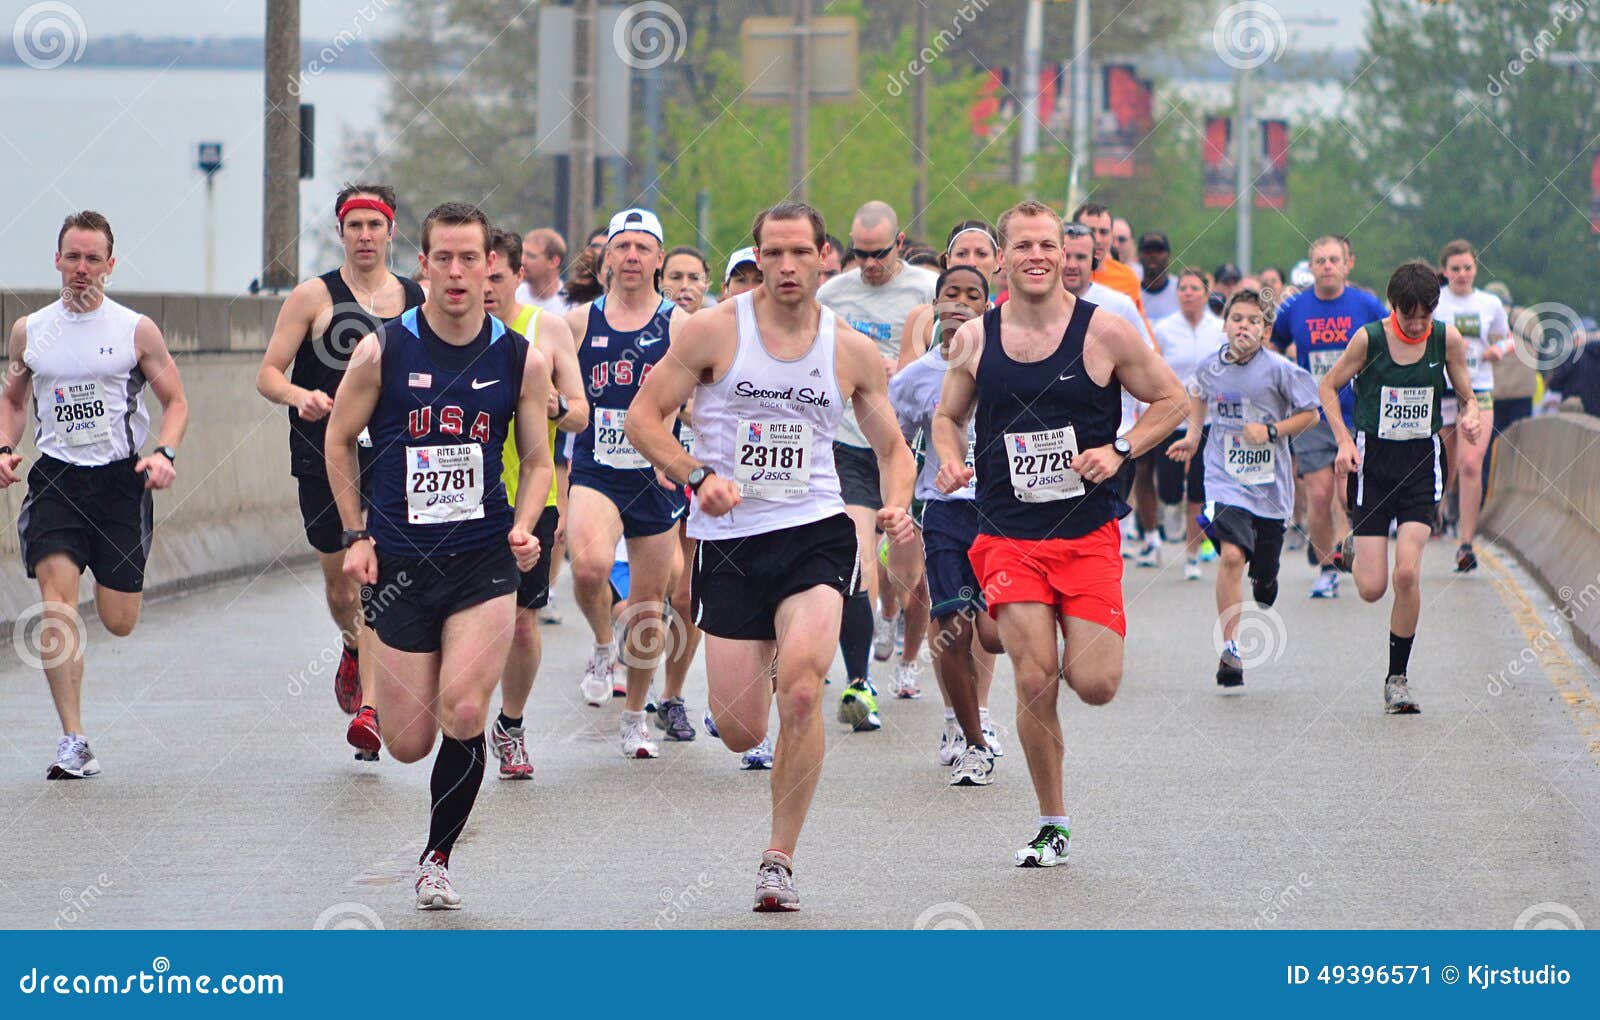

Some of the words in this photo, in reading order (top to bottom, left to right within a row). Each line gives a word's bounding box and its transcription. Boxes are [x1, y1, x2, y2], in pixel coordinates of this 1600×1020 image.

[1305, 316, 1351, 331] TEAM
[1311, 329, 1348, 345] FOX
[735, 381, 793, 400] Second
[796, 388, 830, 408] Sole
[55, 400, 104, 422] 23658
[1218, 403, 1243, 418] CLE
[1385, 403, 1429, 419] 23596
[408, 405, 490, 443] USA
[770, 424, 787, 432] RITE
[789, 424, 803, 432] AID
[599, 427, 626, 445] 237
[1032, 433, 1049, 442] RITE
[1051, 431, 1064, 440] AID
[437, 448, 455, 456] RITE
[458, 447, 471, 455] AID
[740, 444, 804, 469] 23181
[1229, 449, 1270, 465] 23600
[1013, 450, 1073, 475] 22728
[412, 468, 474, 493] 23781
[764, 471, 791, 480] asics
[1039, 474, 1064, 485] asics
[440, 493, 465, 503] asics
